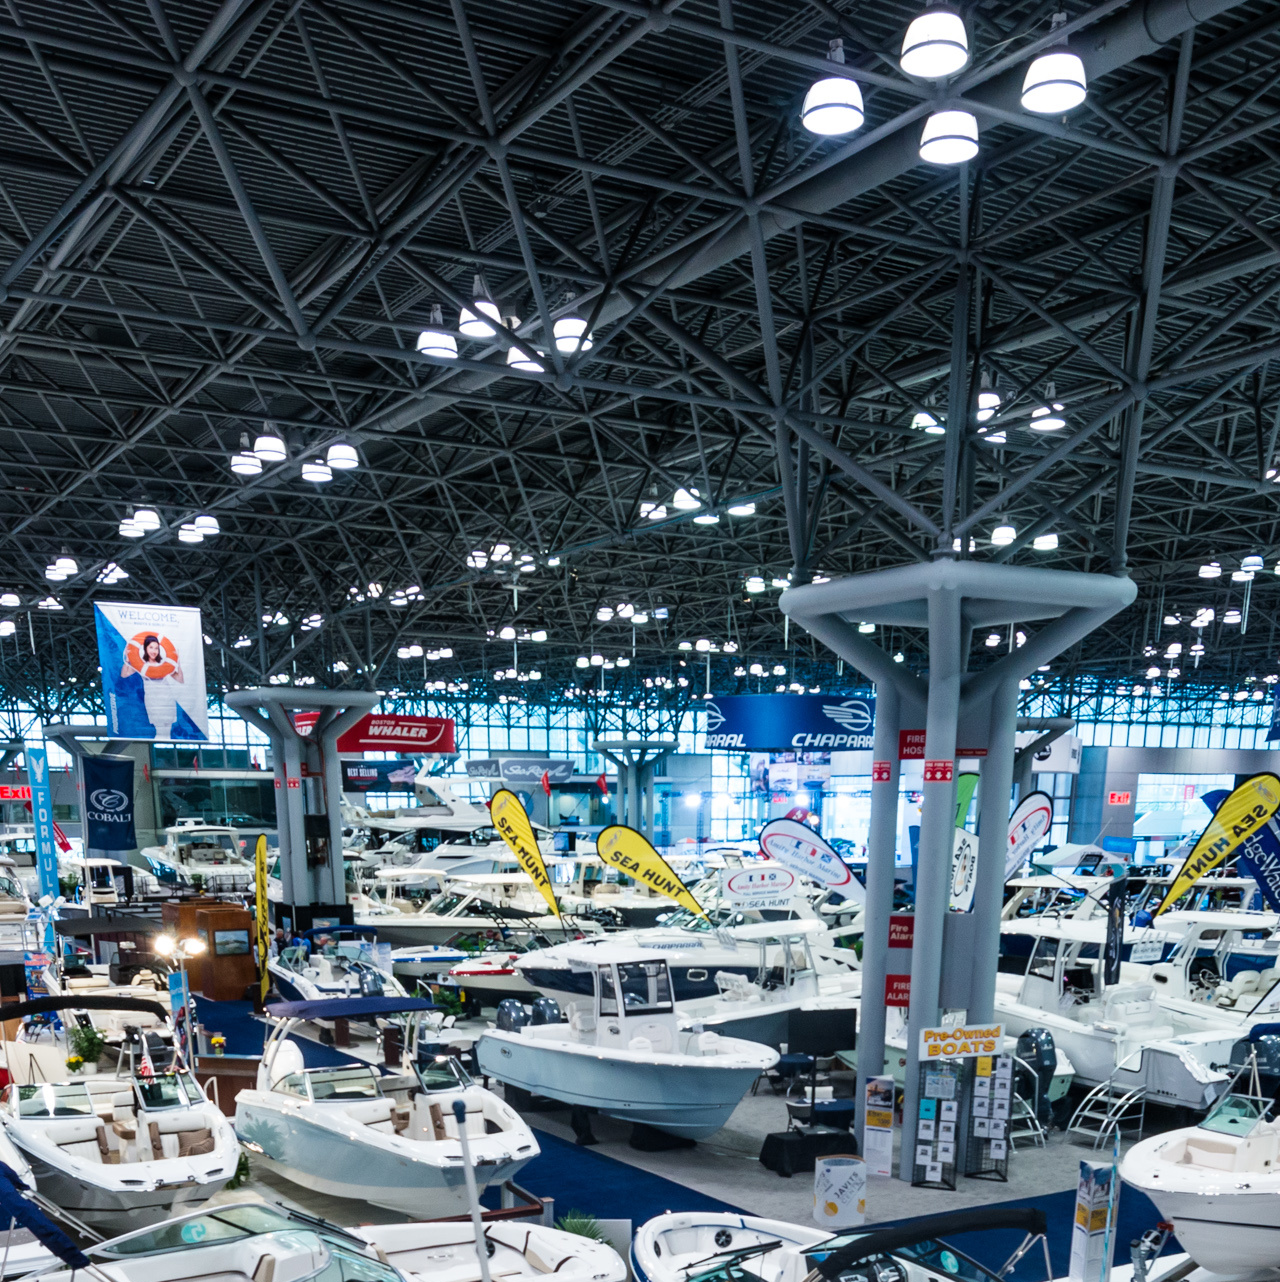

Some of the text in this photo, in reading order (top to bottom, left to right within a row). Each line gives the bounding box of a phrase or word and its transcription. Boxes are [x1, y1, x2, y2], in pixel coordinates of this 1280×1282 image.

[118, 610, 180, 624] WELCOME,
[368, 725, 428, 738] WHALER
[706, 733, 747, 748] ARRAL
[791, 733, 875, 748] CHAPARR
[906, 735, 925, 743] FIRE
[347, 768, 378, 778] BEST SELLING
[0, 786, 32, 799] Exit
[1109, 792, 1131, 805] Exit
[498, 817, 550, 888] SEA HUNT
[610, 851, 686, 898] SEA HUNT
[768, 898, 790, 907] HUNT
[890, 924, 909, 932] Fire
[893, 982, 910, 991] FIRE
[887, 992, 910, 1001] ALAR
[924, 1025, 1002, 1043] Pre-Owned
[927, 1040, 996, 1057] BOATS
[833, 1170, 859, 1199] JAVITS
